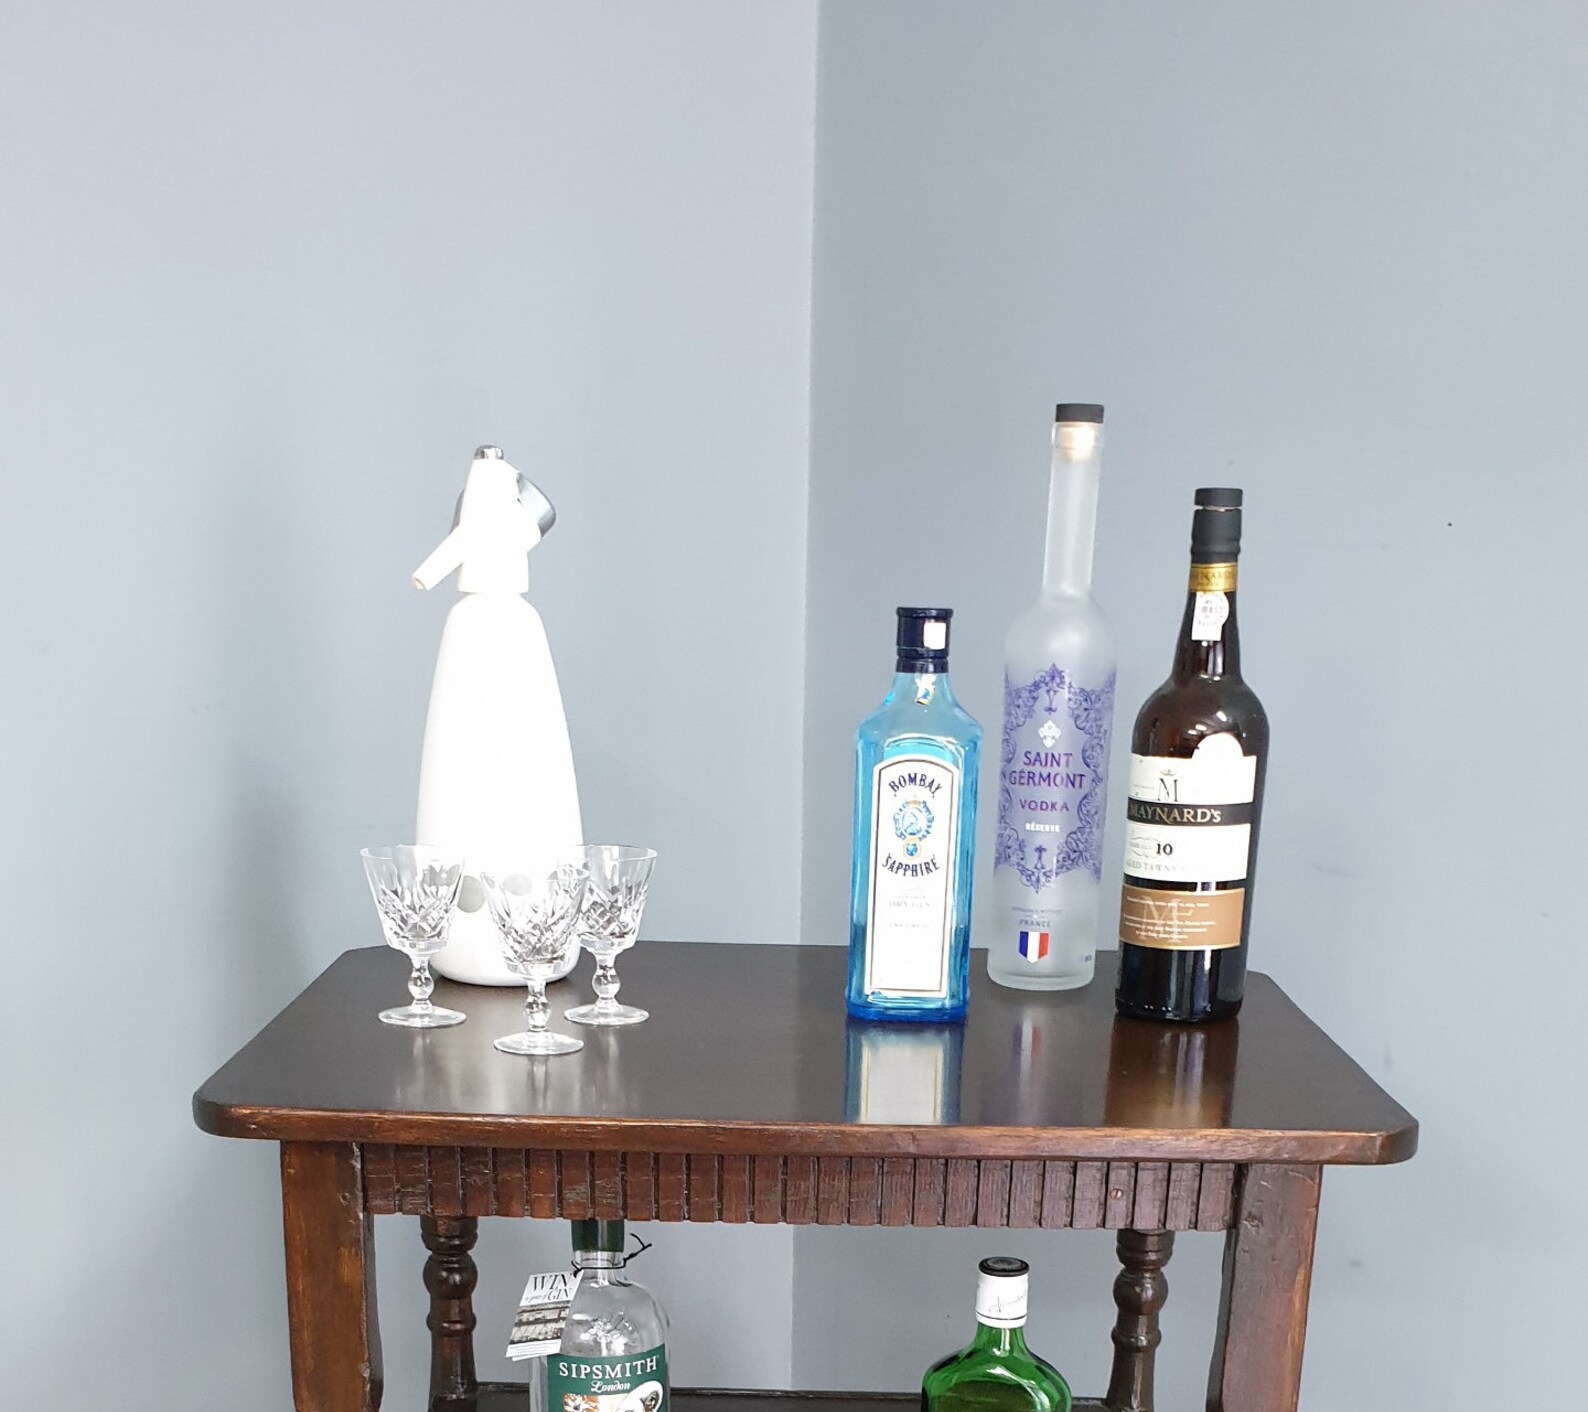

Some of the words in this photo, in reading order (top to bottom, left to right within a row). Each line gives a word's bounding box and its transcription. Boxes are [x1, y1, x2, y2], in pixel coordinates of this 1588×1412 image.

[1023, 751, 1073, 768] SAINT
[888, 773, 942, 798] BOMBAY
[1158, 778, 1178, 802] M
[1019, 799, 1069, 812] VODKA
[1156, 843, 1174, 856] 10
[881, 853, 940, 877] SAPPHIRE
[559, 1355, 658, 1380] SIPSMITH
[590, 1380, 631, 1393] London
